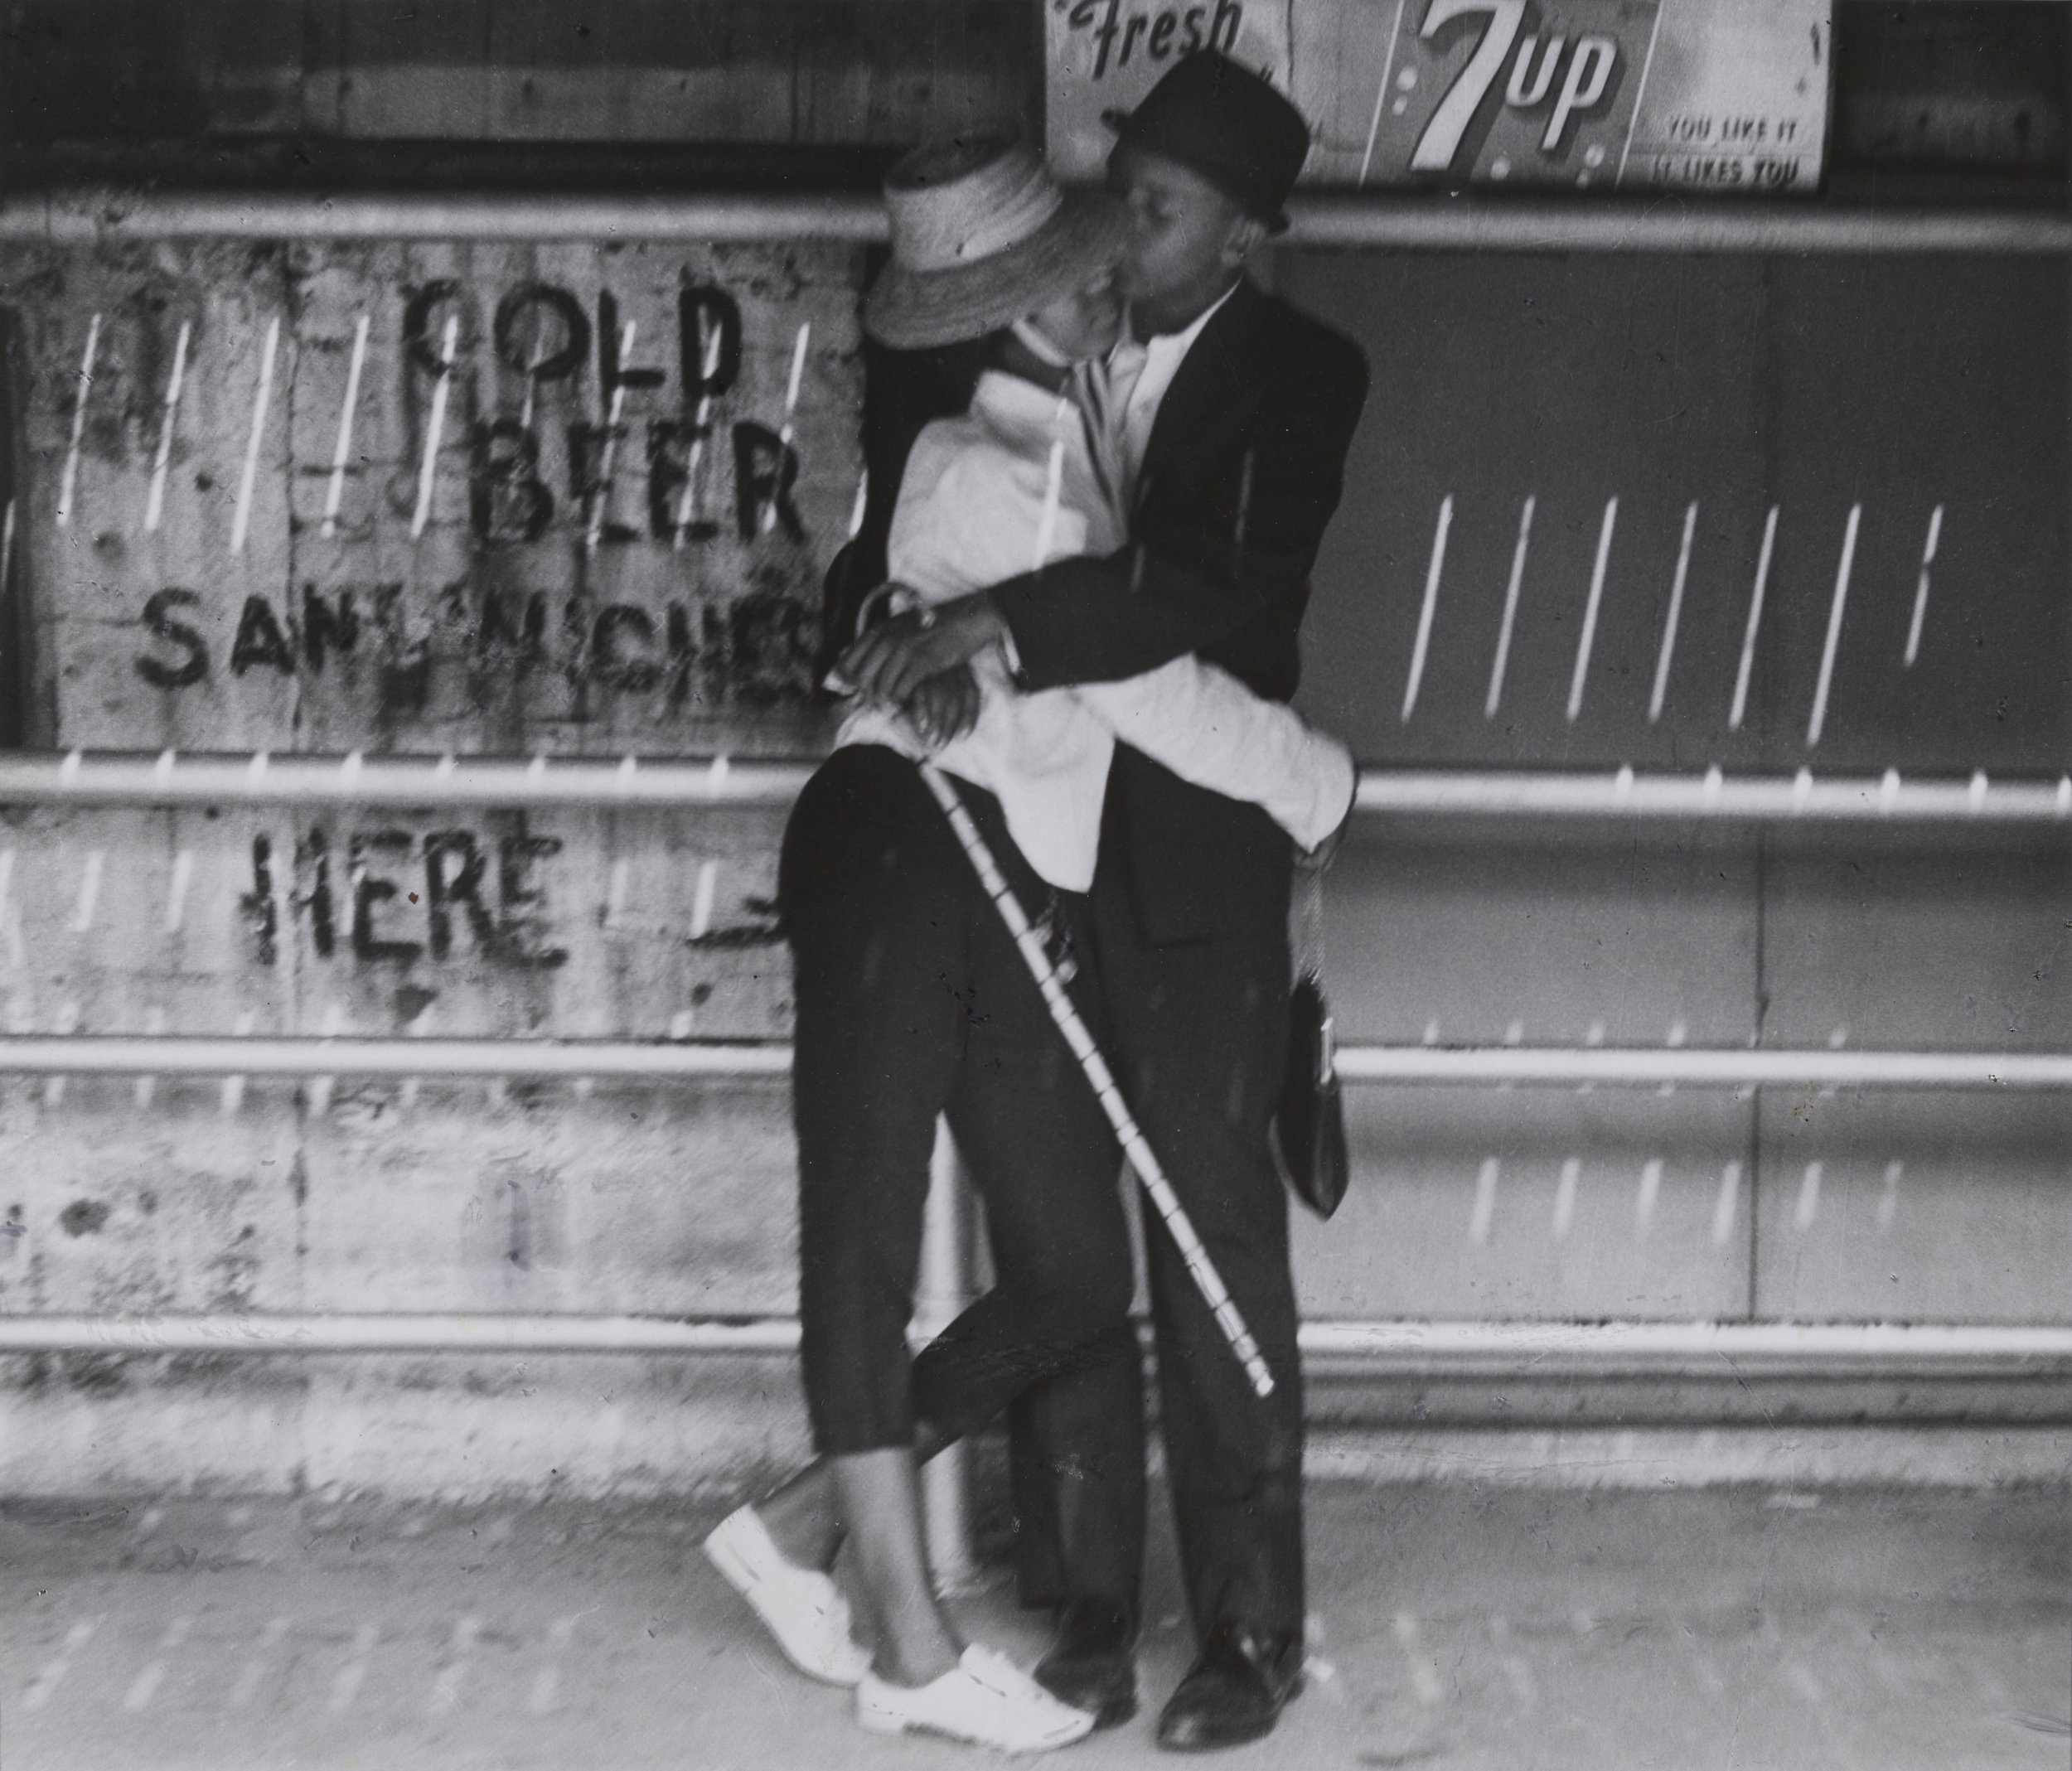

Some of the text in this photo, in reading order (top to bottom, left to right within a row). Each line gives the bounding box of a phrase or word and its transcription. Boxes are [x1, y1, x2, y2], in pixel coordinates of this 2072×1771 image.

[1668, 116, 1797, 143] YOU LIKE IT
[1682, 158, 1743, 185] LIKES
[1754, 158, 1799, 185] YOU
[401, 278, 743, 408] COLD
[469, 420, 809, 544] BEER
[242, 829, 568, 966] HERE
